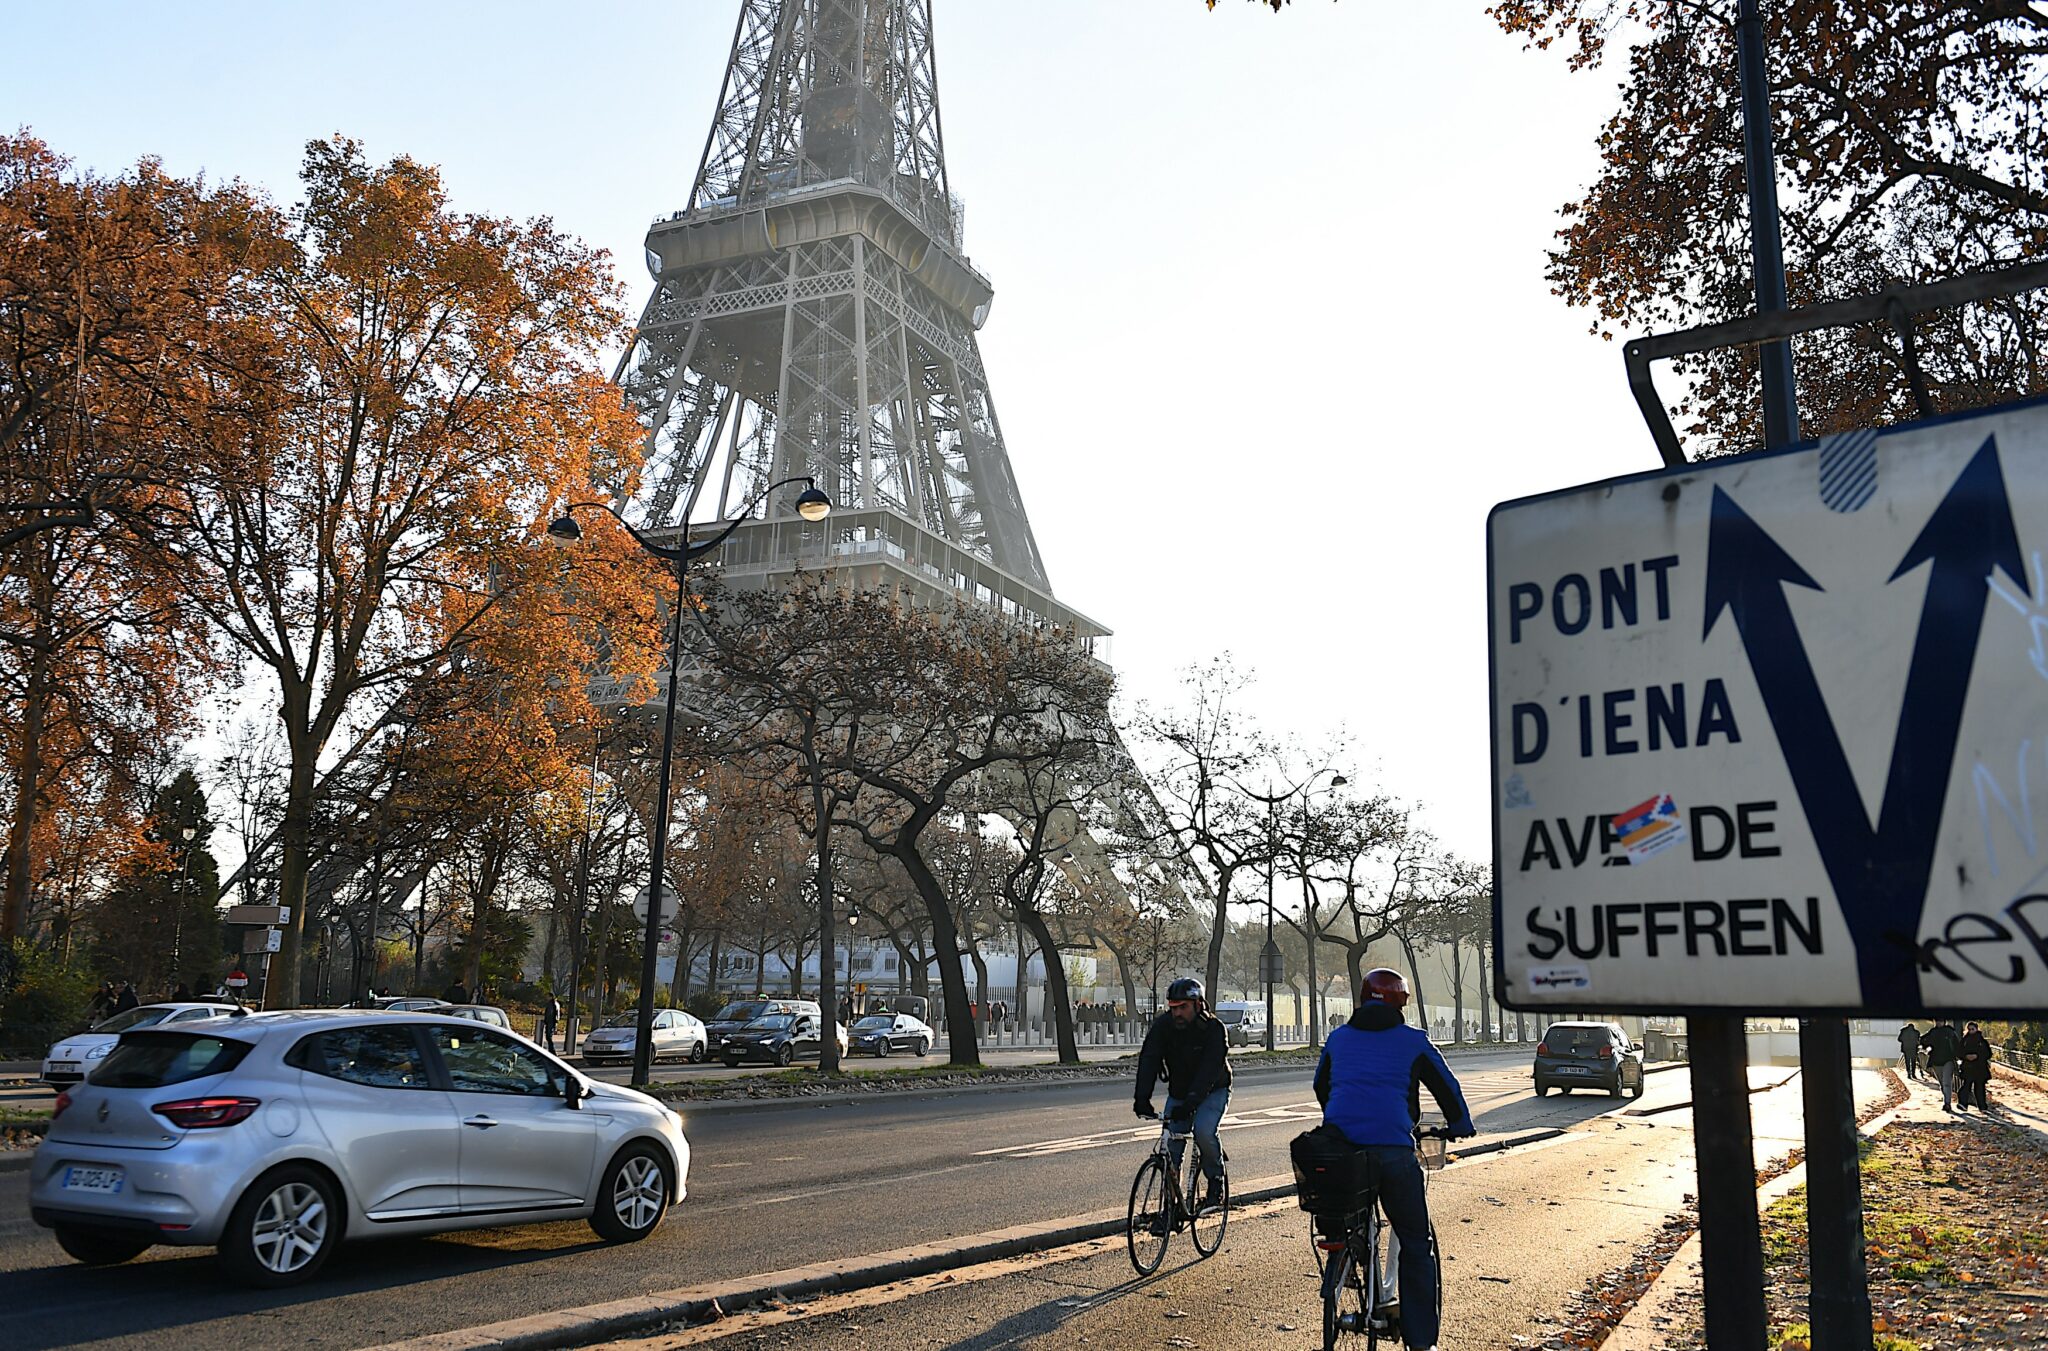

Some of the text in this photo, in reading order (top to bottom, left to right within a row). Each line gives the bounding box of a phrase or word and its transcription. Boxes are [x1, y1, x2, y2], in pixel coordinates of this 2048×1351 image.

[1509, 554, 1679, 645] PONT
[1689, 800, 1782, 862] DE
[1526, 897, 1824, 961] SUFFREN
